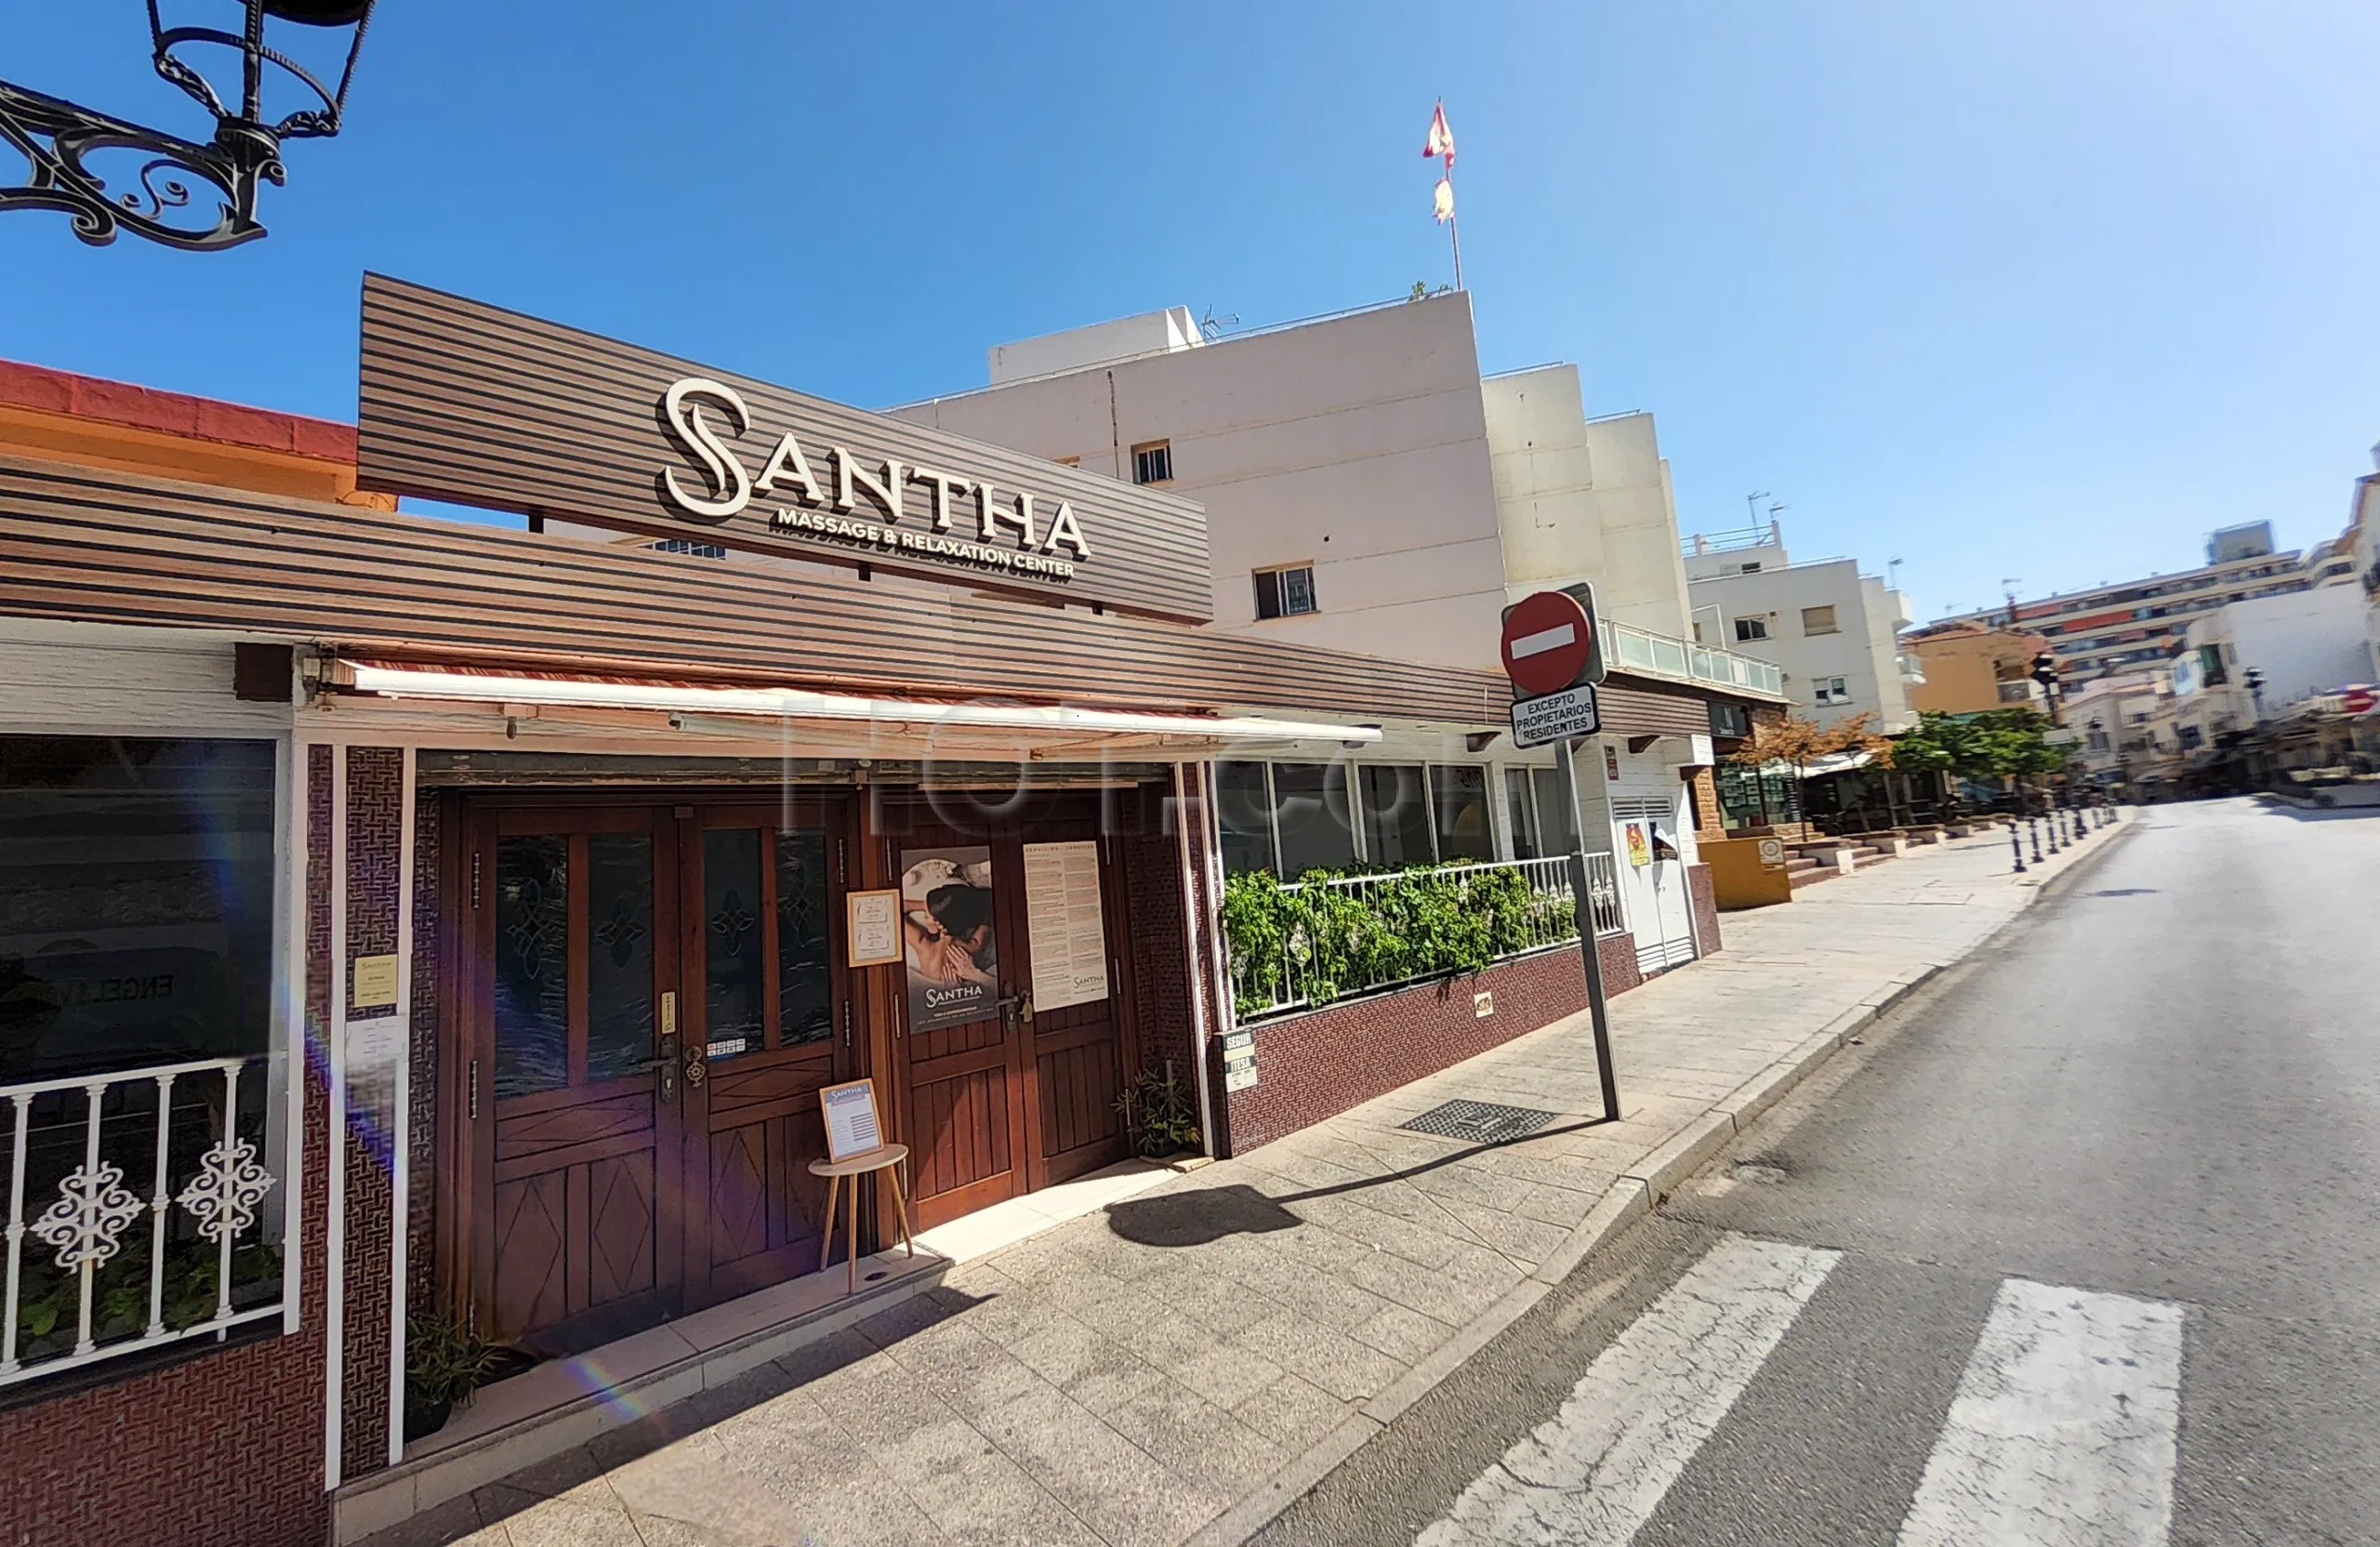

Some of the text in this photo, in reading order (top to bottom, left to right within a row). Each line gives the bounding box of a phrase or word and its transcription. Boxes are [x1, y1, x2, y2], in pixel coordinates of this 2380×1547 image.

[664, 377, 1091, 557] SANTHA
[777, 508, 1076, 577] MASSAGE & RELAXATION CENTER
[1527, 693, 1576, 715] EXCEPTO
[1516, 702, 1592, 731] PROPIETARIOS
[1523, 717, 1588, 742] RESIDENTES
[1073, 974, 1104, 989] SANTHA
[926, 985, 983, 1008] SANTHA
[1226, 1033, 1252, 1050] SEGUR
